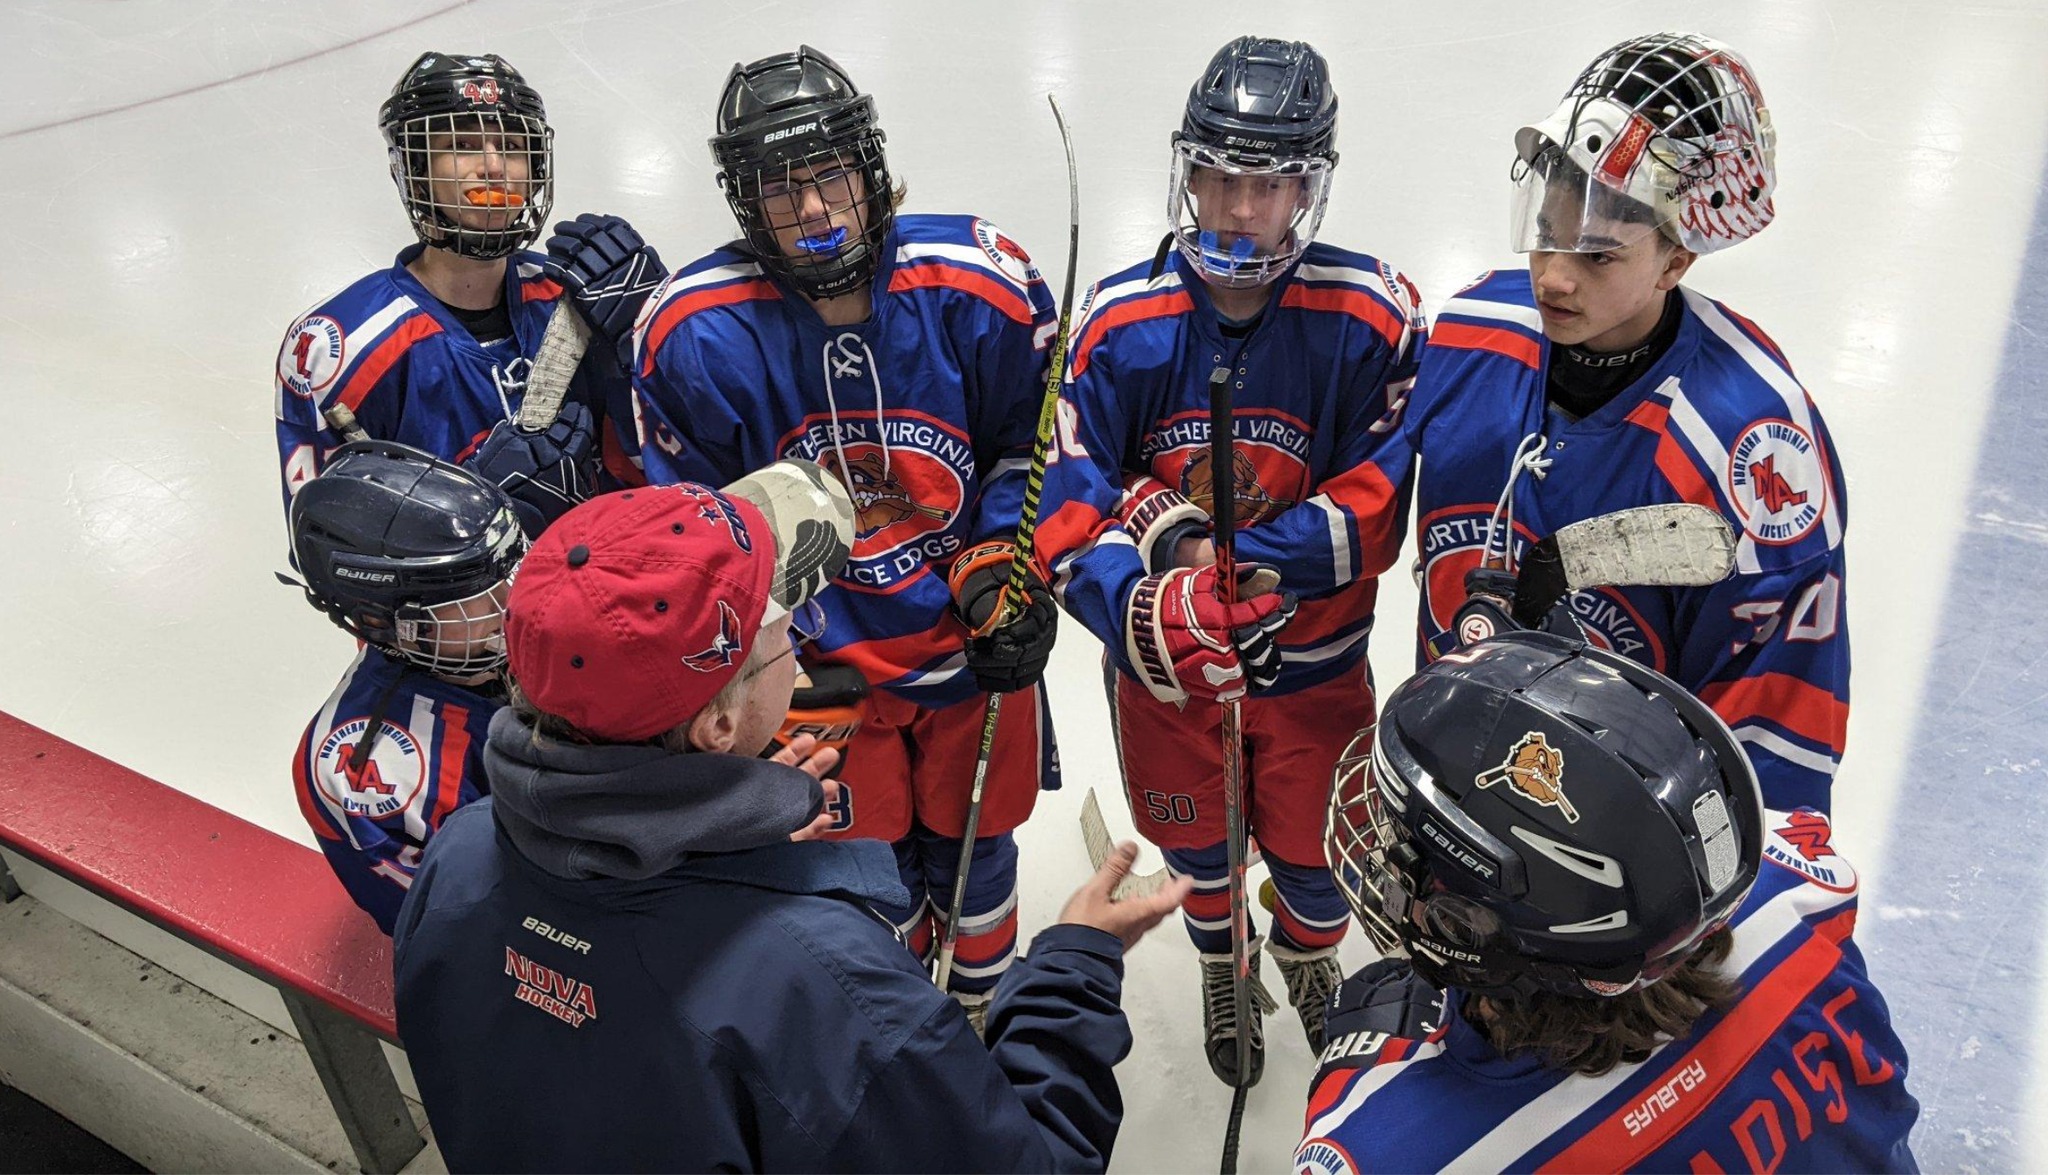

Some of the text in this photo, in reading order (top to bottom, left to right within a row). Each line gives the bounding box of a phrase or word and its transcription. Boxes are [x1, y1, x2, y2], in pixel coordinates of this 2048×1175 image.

[464, 80, 499, 104] 43
[764, 122, 817, 144] BAUER
[1733, 424, 1810, 486] NORTHERN VIRGINIA
[1793, 504, 1817, 531] CLUB
[893, 534, 961, 575] DOGS
[335, 567, 396, 583] BAUER
[320, 720, 366, 759] NORTHERN
[981, 711, 997, 753] ALPHA
[1144, 789, 1198, 825] 50
[1421, 822, 1495, 880] BAUER
[1765, 844, 1838, 886] NORTHERN
[521, 915, 592, 956] BAUER
[1420, 938, 1482, 964] BAUER
[504, 945, 598, 1020] NOVA
[514, 983, 586, 1030] HOCKEY
[1295, 1144, 1346, 1175] NORTHERN
